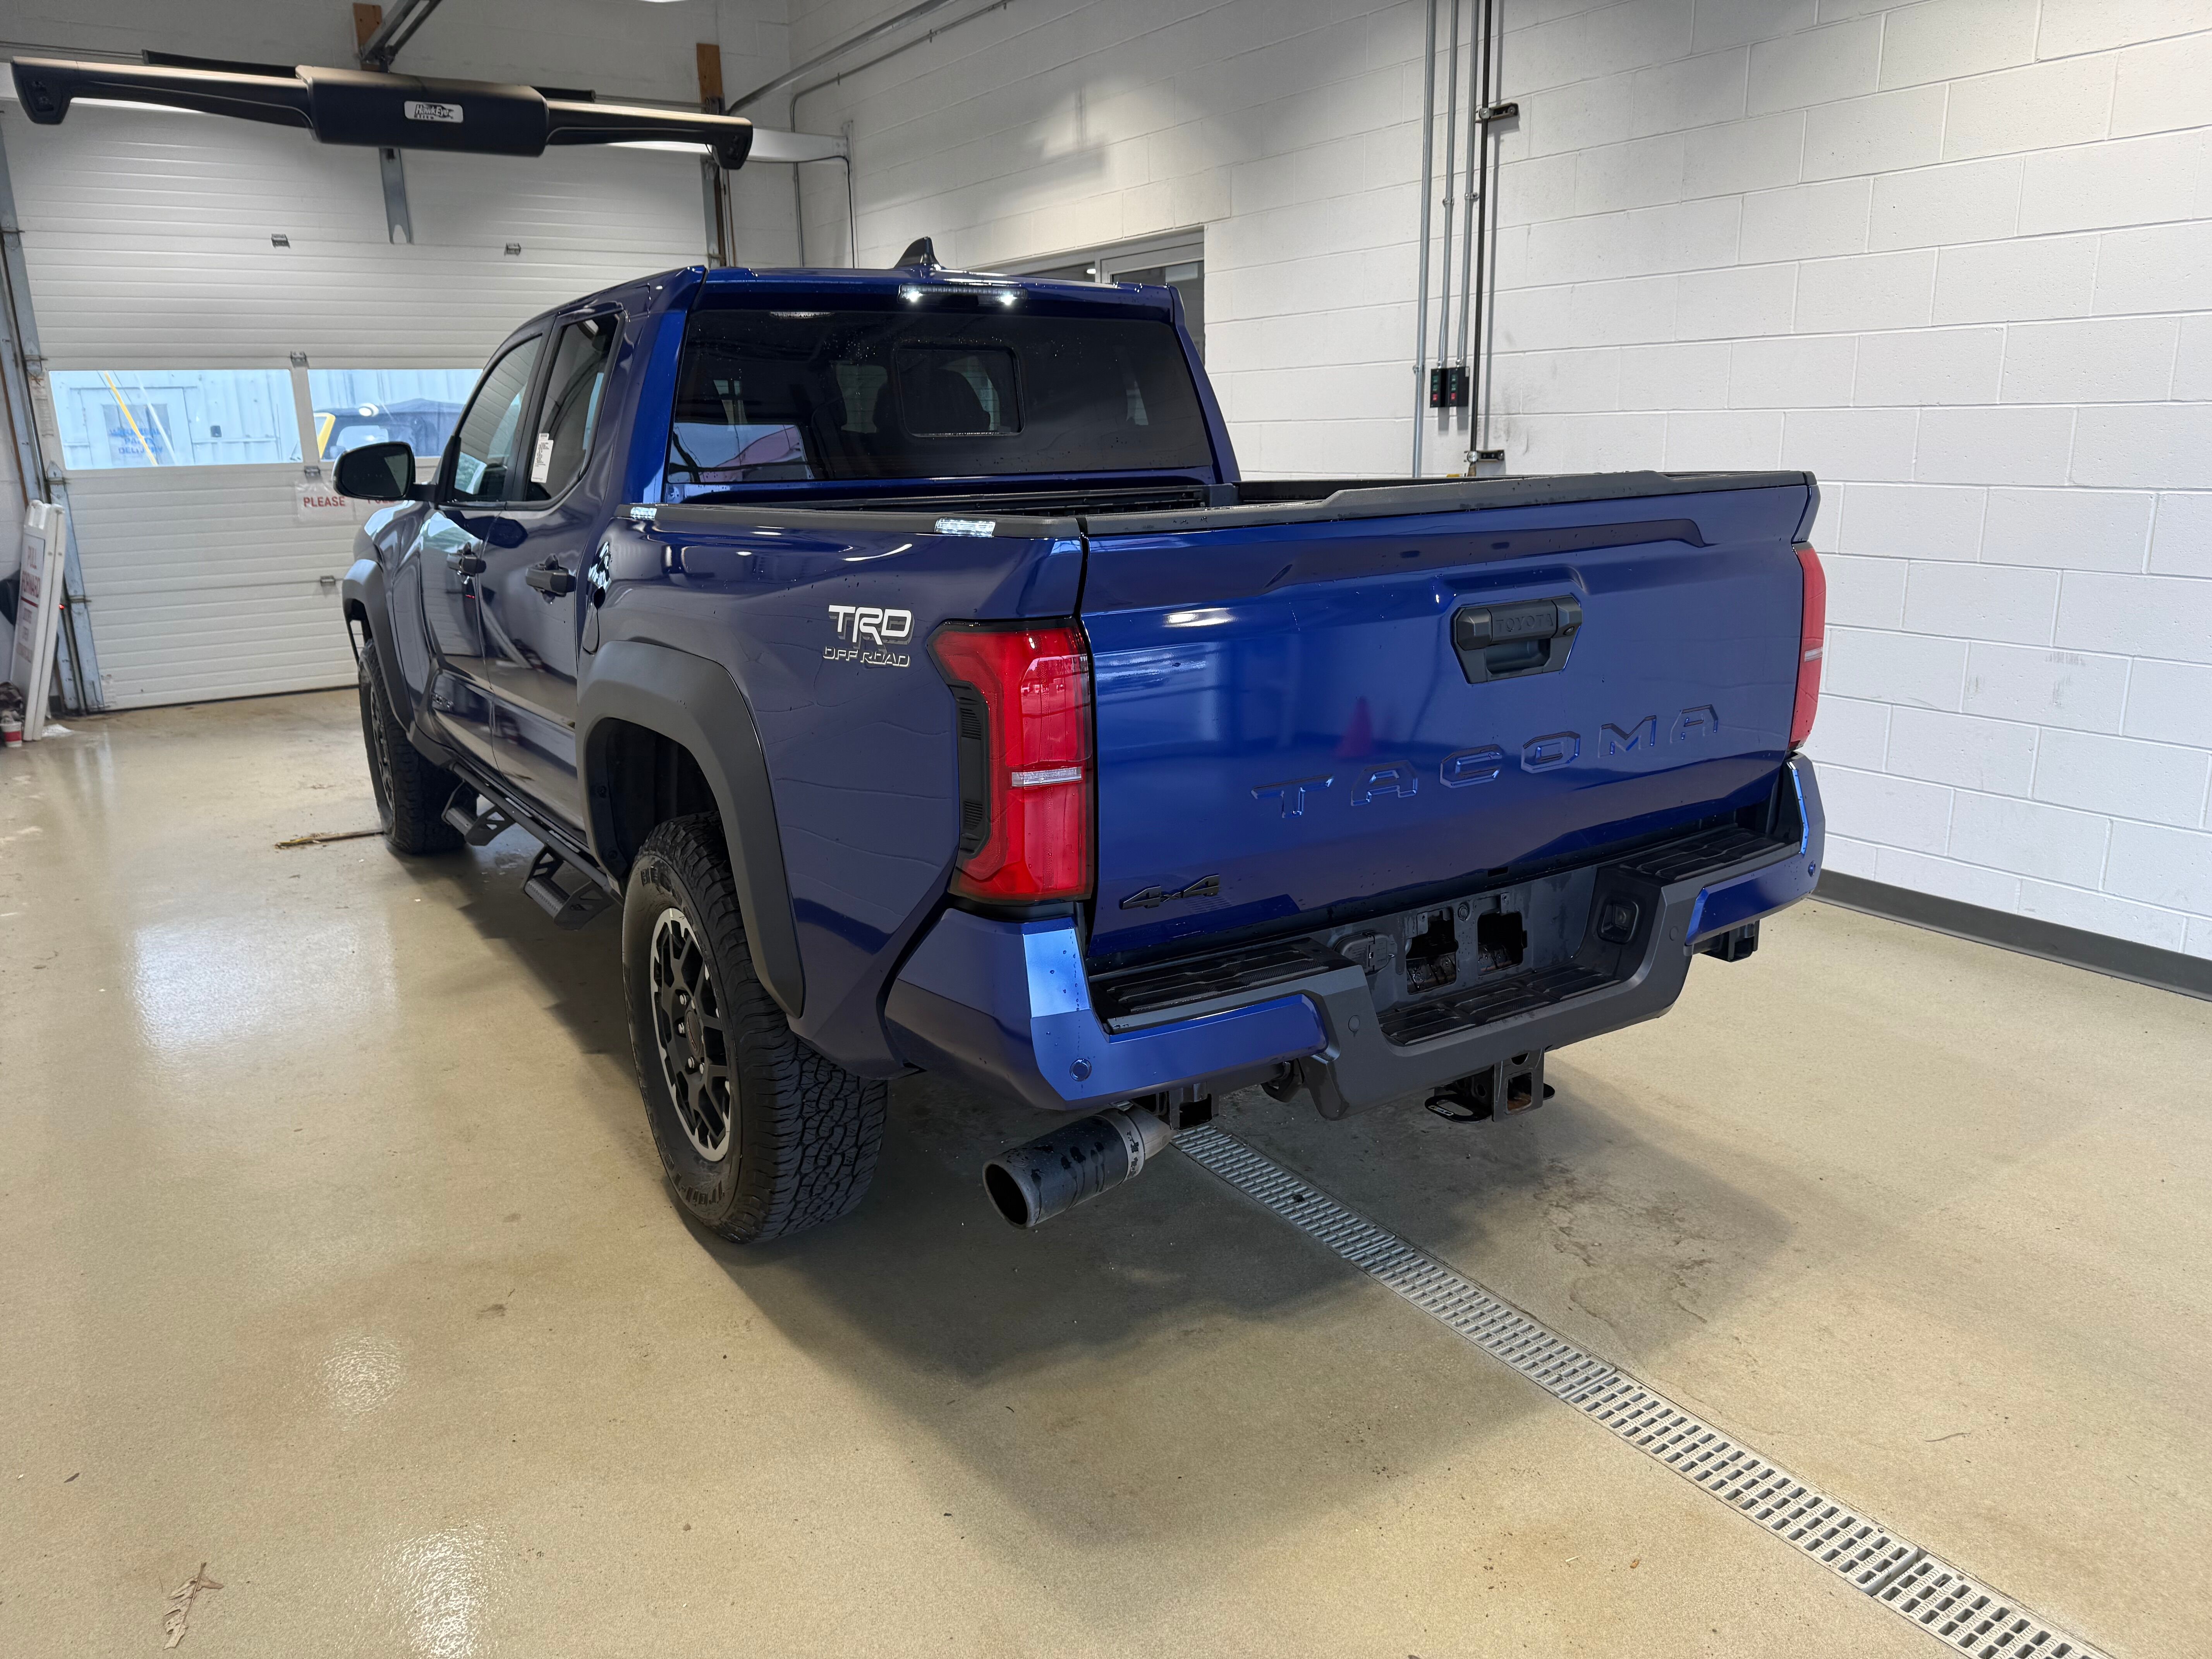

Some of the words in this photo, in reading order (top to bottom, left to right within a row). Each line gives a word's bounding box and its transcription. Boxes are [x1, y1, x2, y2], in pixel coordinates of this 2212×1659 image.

[303, 496, 346, 507] PLEASE
[828, 605, 913, 646] TRD
[823, 646, 858, 661] OFF
[860, 650, 911, 668] ROAD
[1250, 704, 1718, 818] TACOMA
